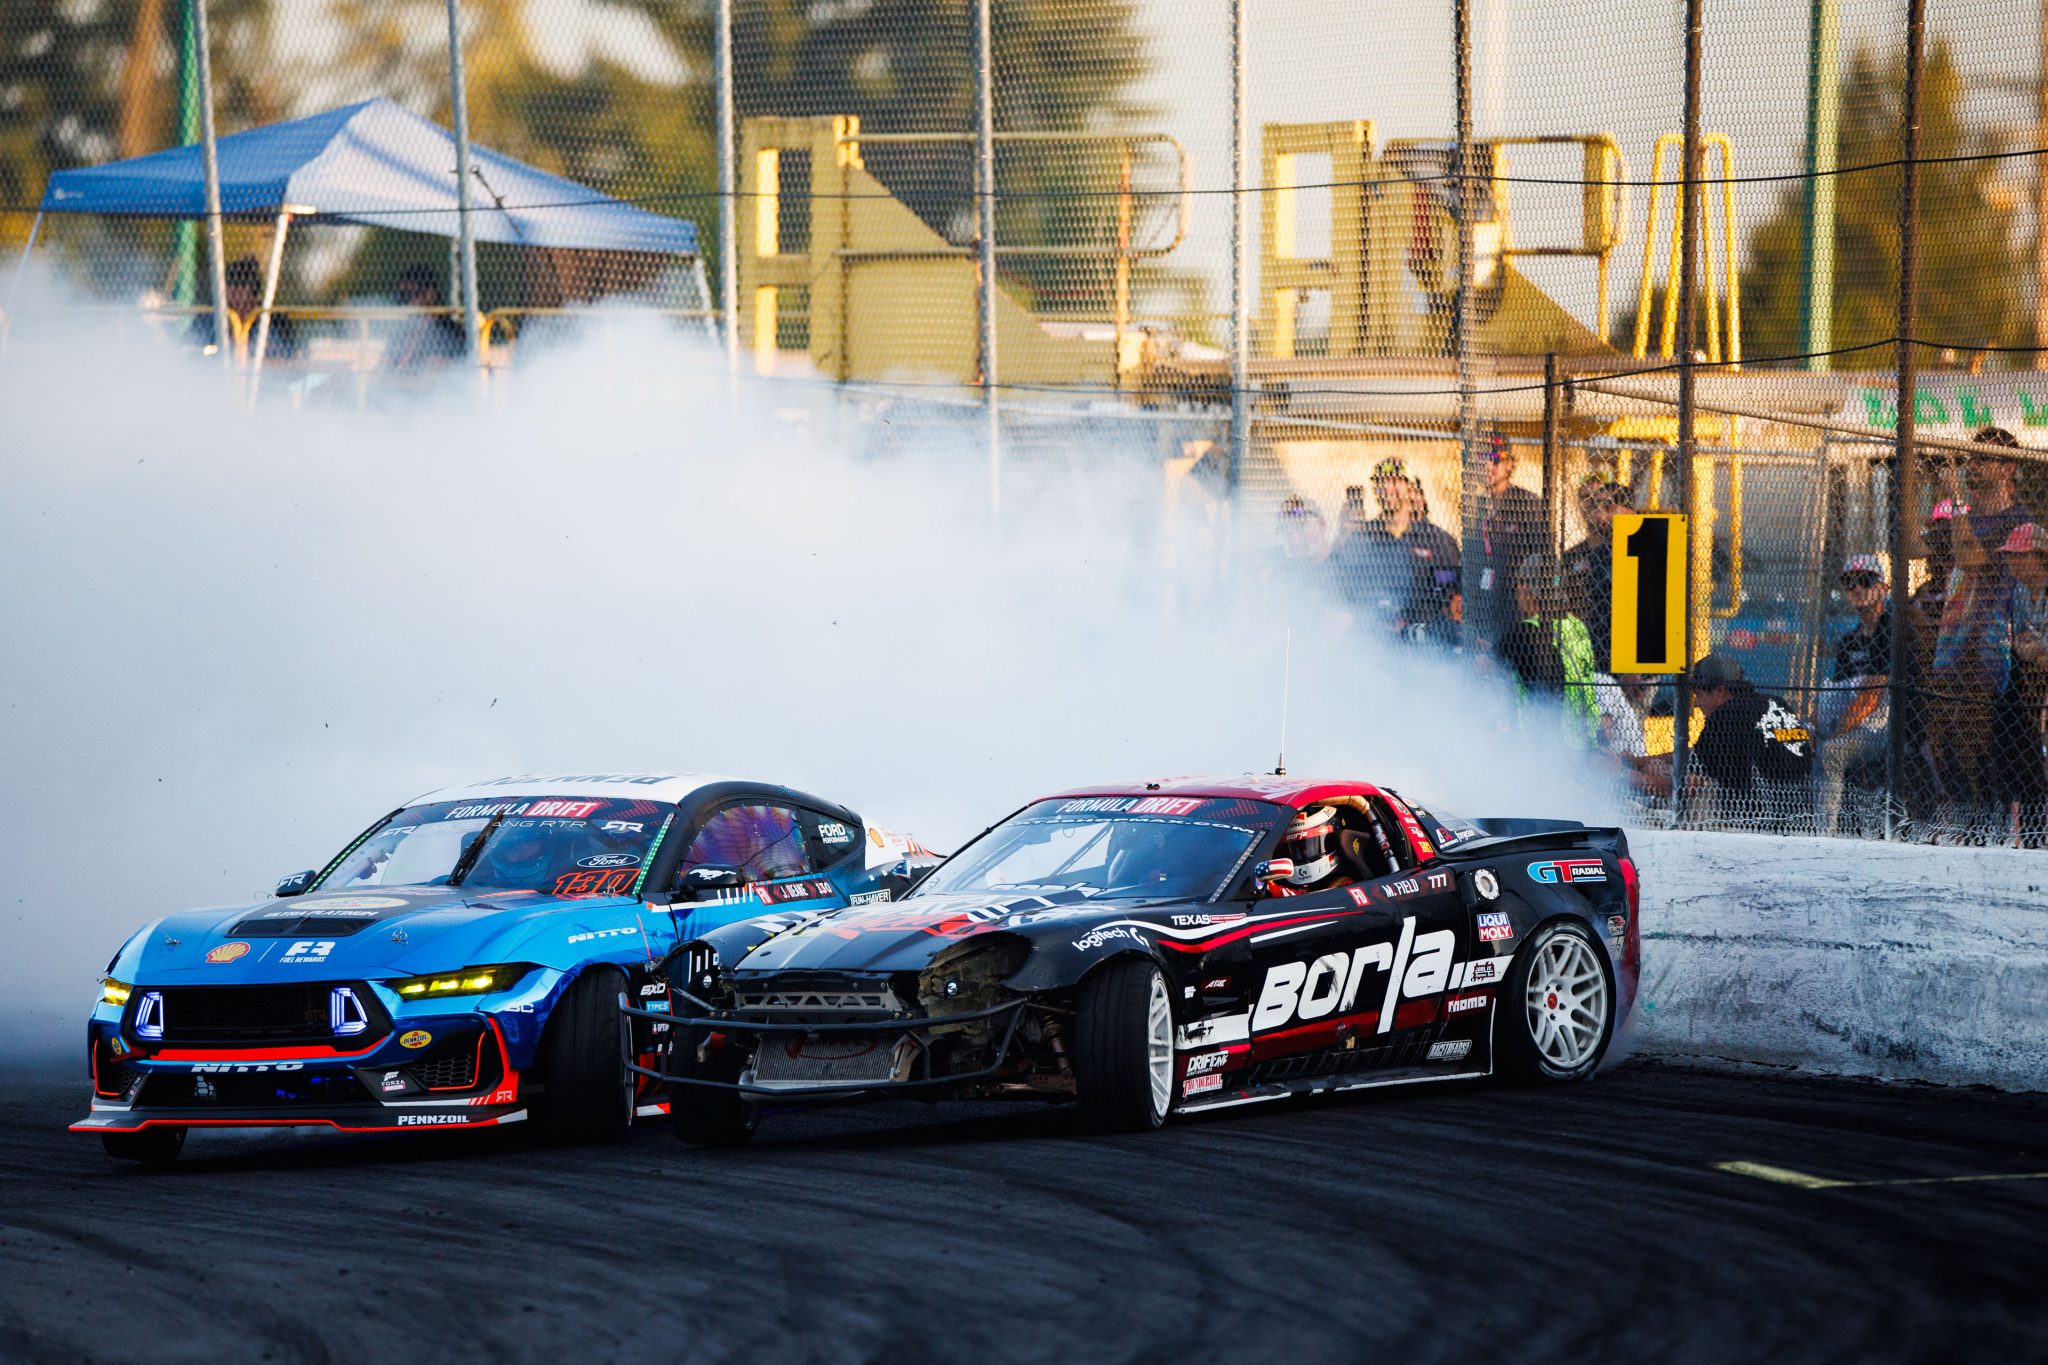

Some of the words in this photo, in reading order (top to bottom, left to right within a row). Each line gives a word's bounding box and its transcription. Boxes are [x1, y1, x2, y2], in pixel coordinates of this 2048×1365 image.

[1627, 518, 1669, 663] 1
[444, 803, 530, 819] FORMULA
[527, 801, 597, 816] DRIFT
[1056, 799, 1137, 813] FORMULA
[1132, 797, 1200, 815] DRIFT
[540, 820, 587, 829] RTR
[818, 823, 846, 837] FORD
[822, 835, 850, 844] PERFORMANCE
[589, 854, 628, 867] Ford
[1527, 859, 1603, 883] GT
[1572, 867, 1605, 875] RADIAL
[552, 868, 642, 895] 130
[815, 881, 832, 894] 130
[1382, 885, 1396, 898] M.
[1397, 878, 1419, 895] FIELD
[1428, 873, 1447, 889] 777
[780, 885, 790, 899] J.
[786, 883, 809, 898] DEANE
[1352, 889, 1368, 905] FD
[851, 892, 889, 906] FUN-HAVER
[1171, 914, 1211, 926] TEXAS
[1478, 914, 1508, 928] LIQUI
[568, 927, 637, 944] NITTO
[1072, 927, 1130, 951] logitech
[1480, 925, 1512, 940] MOLY
[403, 1034, 427, 1044] PENNZOIL
[191, 1061, 304, 1073] NITTO
[381, 1079, 405, 1087] FORZA
[398, 1115, 470, 1126] PENNZOIL
